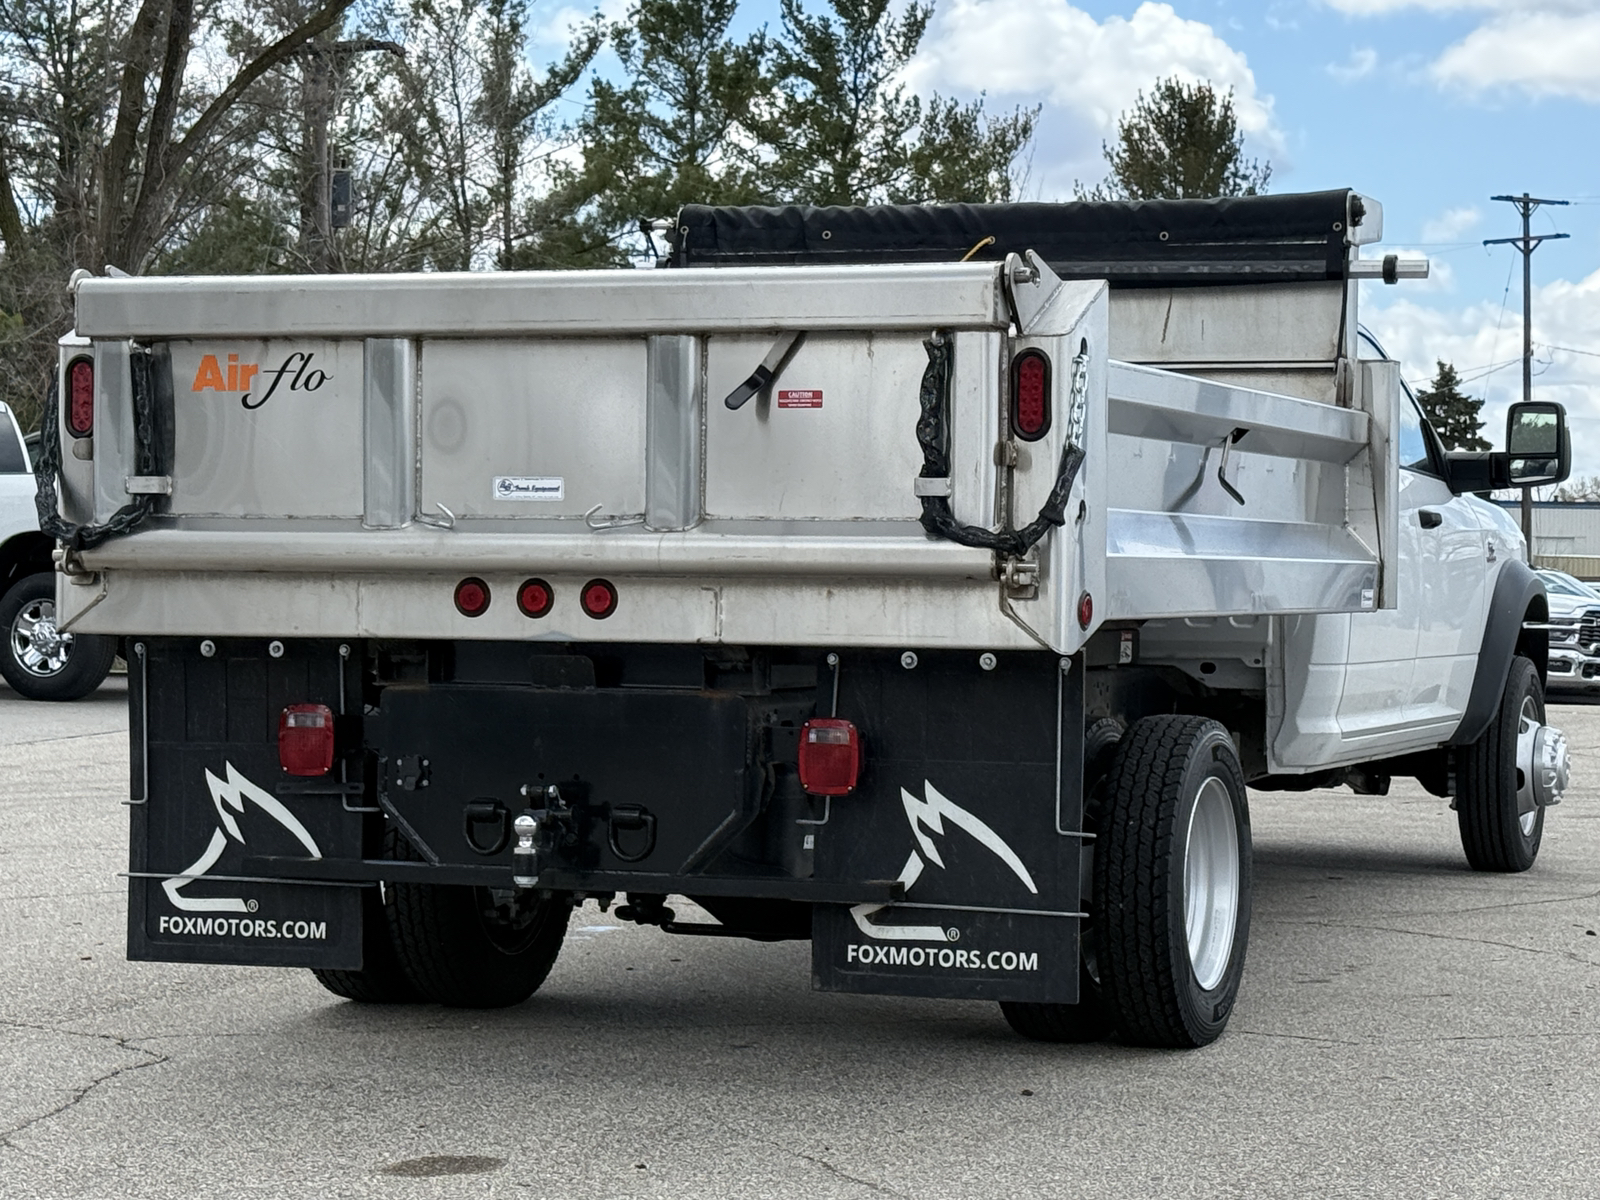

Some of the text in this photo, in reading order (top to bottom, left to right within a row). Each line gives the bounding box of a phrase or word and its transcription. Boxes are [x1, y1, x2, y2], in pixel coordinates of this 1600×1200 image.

[191, 352, 334, 410] Air flo
[788, 391, 813, 399] CAUTION
[159, 916, 327, 940] FOXMOTORS.COM
[847, 944, 1039, 971] FOXMOTORS.COM
